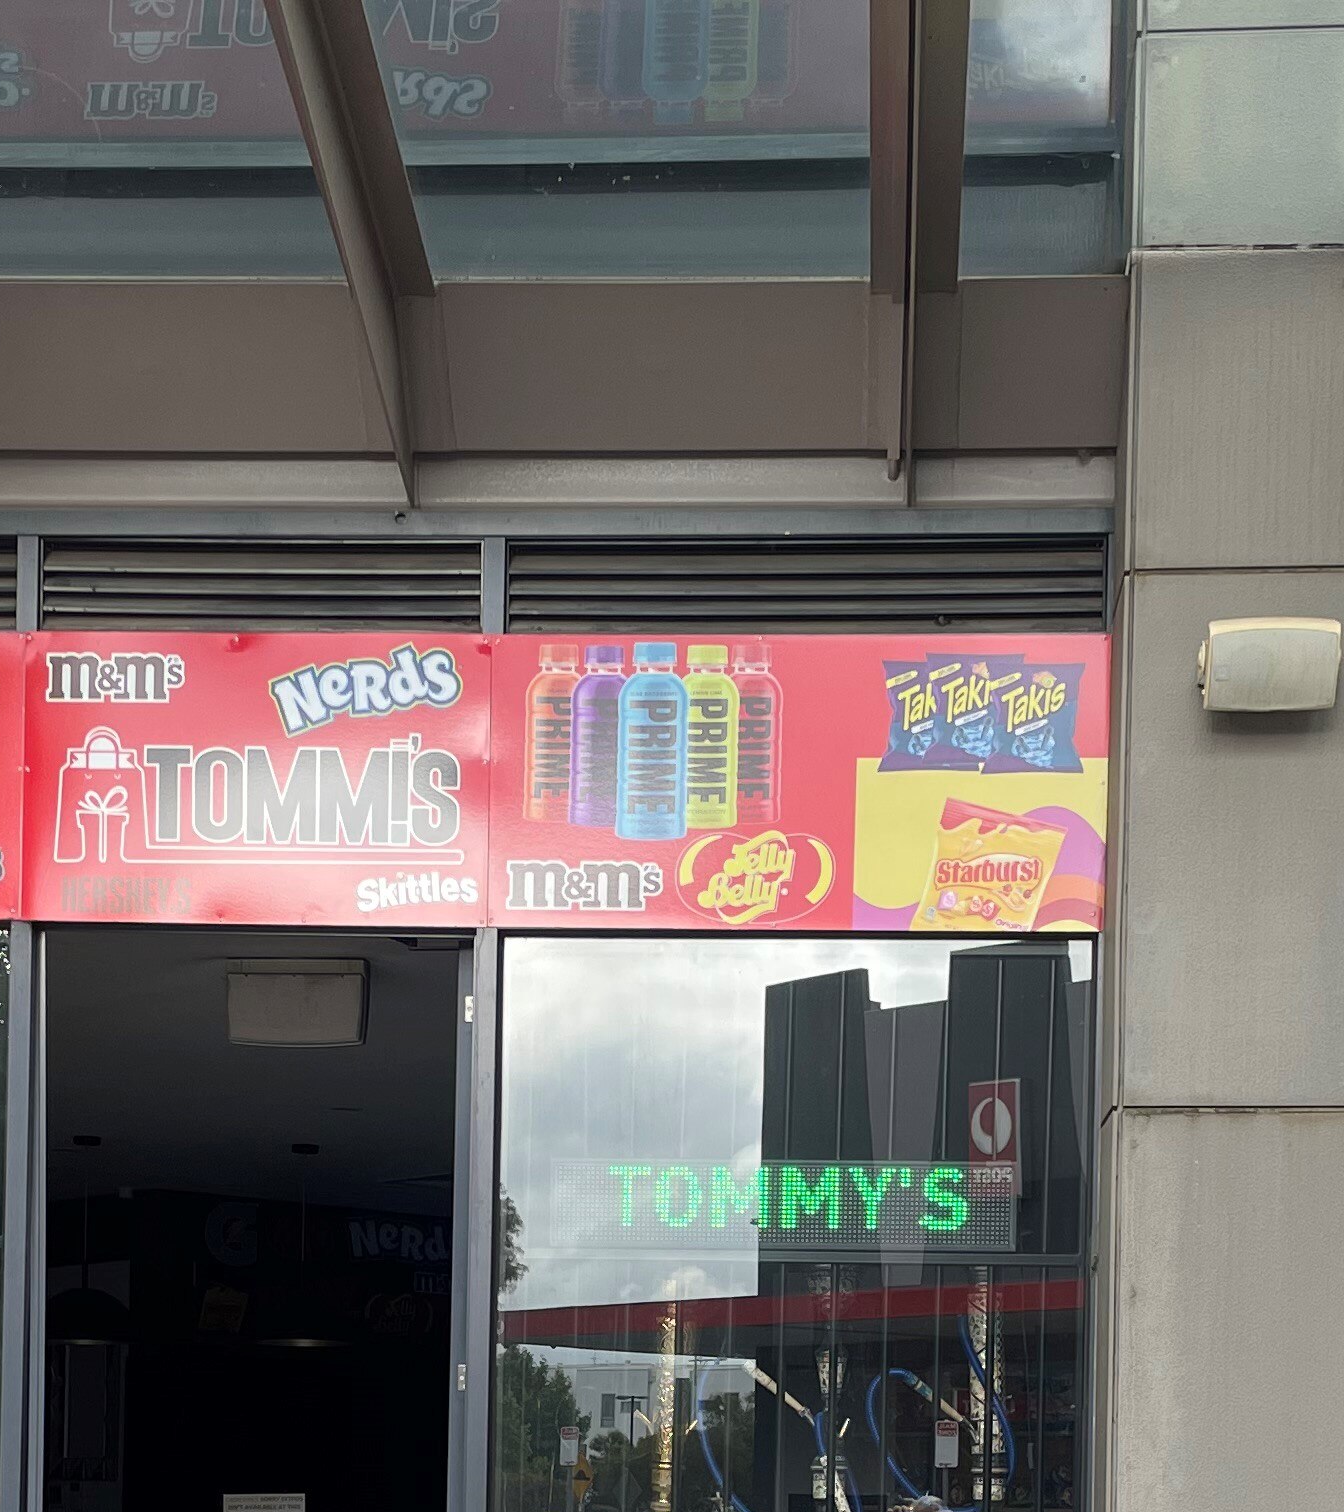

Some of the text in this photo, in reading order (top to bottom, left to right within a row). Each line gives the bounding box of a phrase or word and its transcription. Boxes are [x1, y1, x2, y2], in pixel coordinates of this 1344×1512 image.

[941, 675, 992, 724] Taki
[627, 699, 678, 815] PRIME
[687, 698, 728, 805] PRIME
[737, 696, 772, 801] PRIME
[145, 733, 461, 846] TOMMI'S
[724, 831, 796, 881] Jelly
[937, 859, 1040, 884] Starburst
[357, 873, 478, 912] Skittles
[698, 872, 781, 921] Belly
[608, 1165, 971, 1230] TOMMY'S
